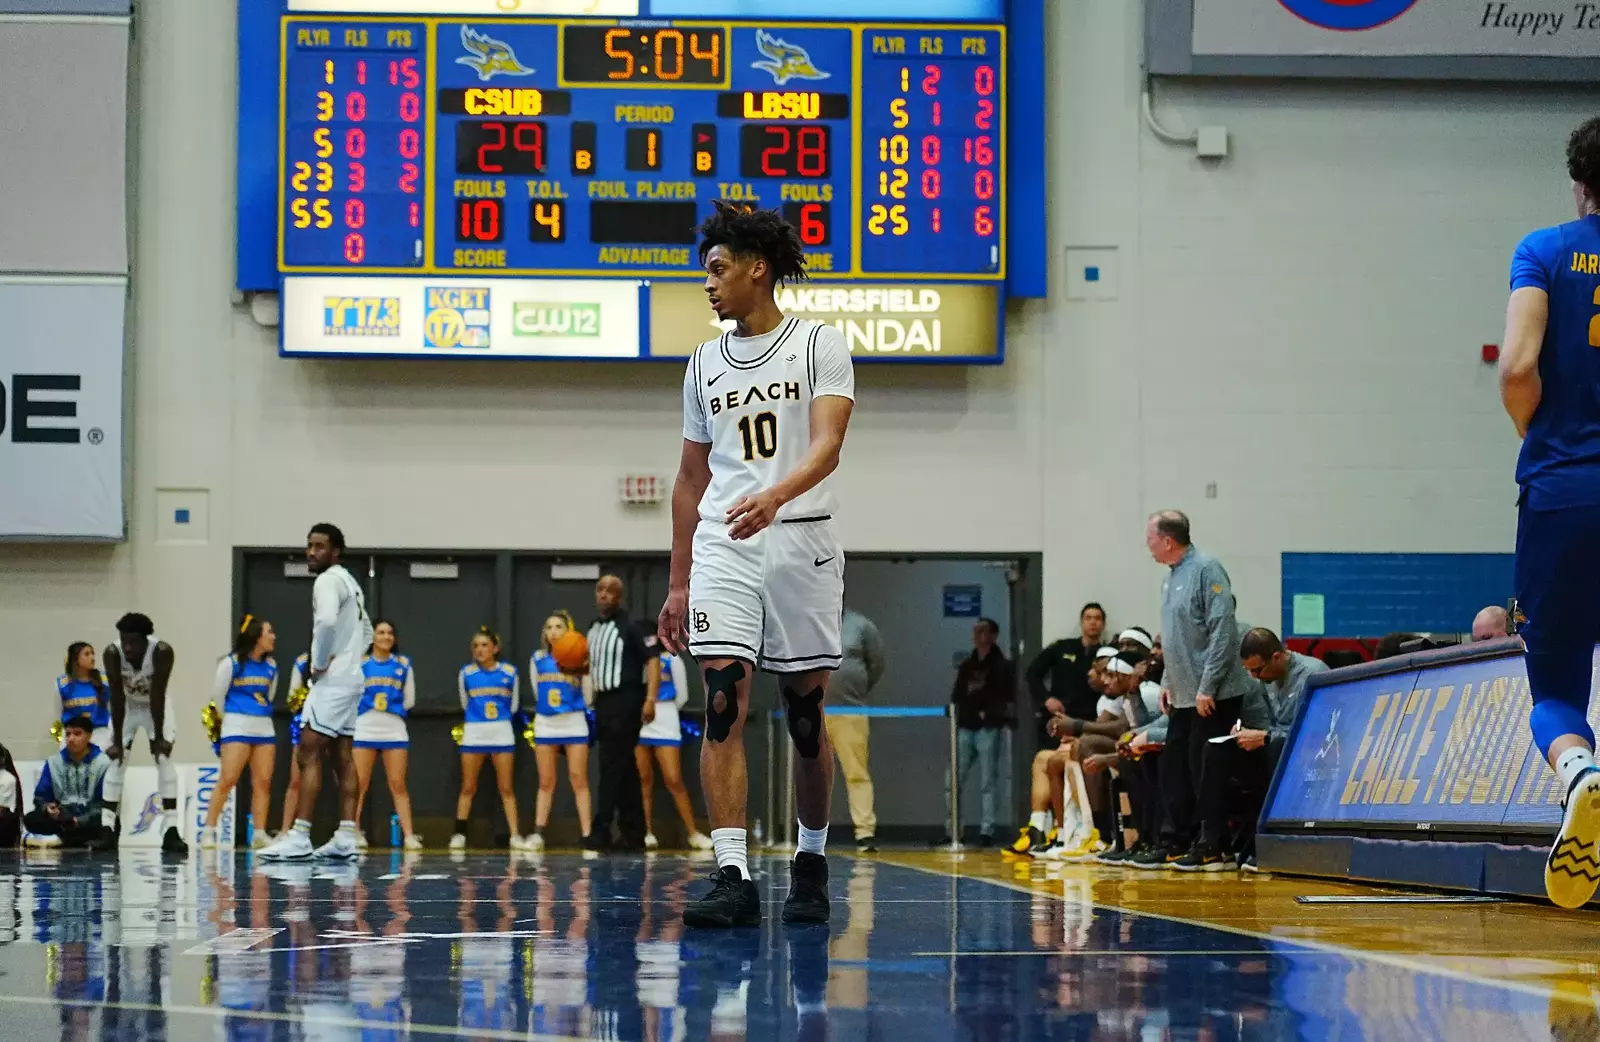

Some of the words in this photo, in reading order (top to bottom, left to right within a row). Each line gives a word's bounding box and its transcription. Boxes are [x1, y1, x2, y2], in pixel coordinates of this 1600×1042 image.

[1481, 3, 1564, 36] Happy
[297, 28, 330, 46] PLYR
[344, 29, 368, 47] FLS
[387, 29, 412, 47] PTS
[872, 36, 905, 54] PLYR
[919, 36, 943, 54] FLS
[961, 37, 986, 55] PTS
[604, 28, 720, 80] 5:04
[325, 59, 334, 85] 1
[357, 60, 367, 85] 1
[389, 58, 420, 89] 15
[901, 67, 909, 92] 1
[922, 65, 941, 96] 2
[975, 65, 994, 96] 0
[316, 90, 334, 122] 3
[345, 91, 366, 122] 0
[400, 92, 419, 122] 0
[464, 88, 542, 116] CSUB
[615, 105, 674, 123] PERIOD
[743, 92, 820, 119] LBSU
[890, 98, 909, 129] 5
[932, 101, 942, 126] 1
[974, 99, 994, 130] 2
[313, 127, 334, 158] 5
[345, 127, 366, 159] 0
[399, 128, 419, 159] 0
[477, 123, 542, 172] 29
[647, 132, 656, 167] 1
[762, 126, 826, 177] 28
[879, 134, 909, 165] 10
[921, 135, 941, 165] 0
[964, 135, 994, 166] 16
[575, 150, 592, 170] B
[696, 151, 712, 171] B
[292, 161, 334, 192] 23
[347, 161, 366, 193] 3
[399, 162, 419, 193] 2
[453, 179, 506, 198] FOULS
[526, 180, 569, 199] T.O.L.
[588, 181, 629, 199] FOUL
[636, 182, 697, 199] PLAYER
[718, 183, 760, 201] T.O.L.
[780, 184, 833, 202] FOULS
[879, 168, 909, 199] 12
[921, 168, 941, 199] 0
[974, 169, 994, 200] 0
[291, 197, 334, 229] 55
[344, 198, 365, 229] 0
[409, 201, 419, 228] 1
[461, 200, 499, 241] 10
[534, 202, 560, 239] 4
[800, 203, 825, 245] 6
[868, 204, 909, 236] 25
[932, 208, 941, 233] 1
[974, 205, 994, 236] 6
[344, 232, 365, 264] 0
[453, 249, 507, 268] SCORE
[598, 247, 690, 266] ADVANTAGE
[1571, 251, 1600, 275] JAR
[0, 374, 81, 444] E
[710, 381, 800, 416] BEACH
[738, 411, 778, 462] 10
[1339, 685, 1455, 805] EAGLE
